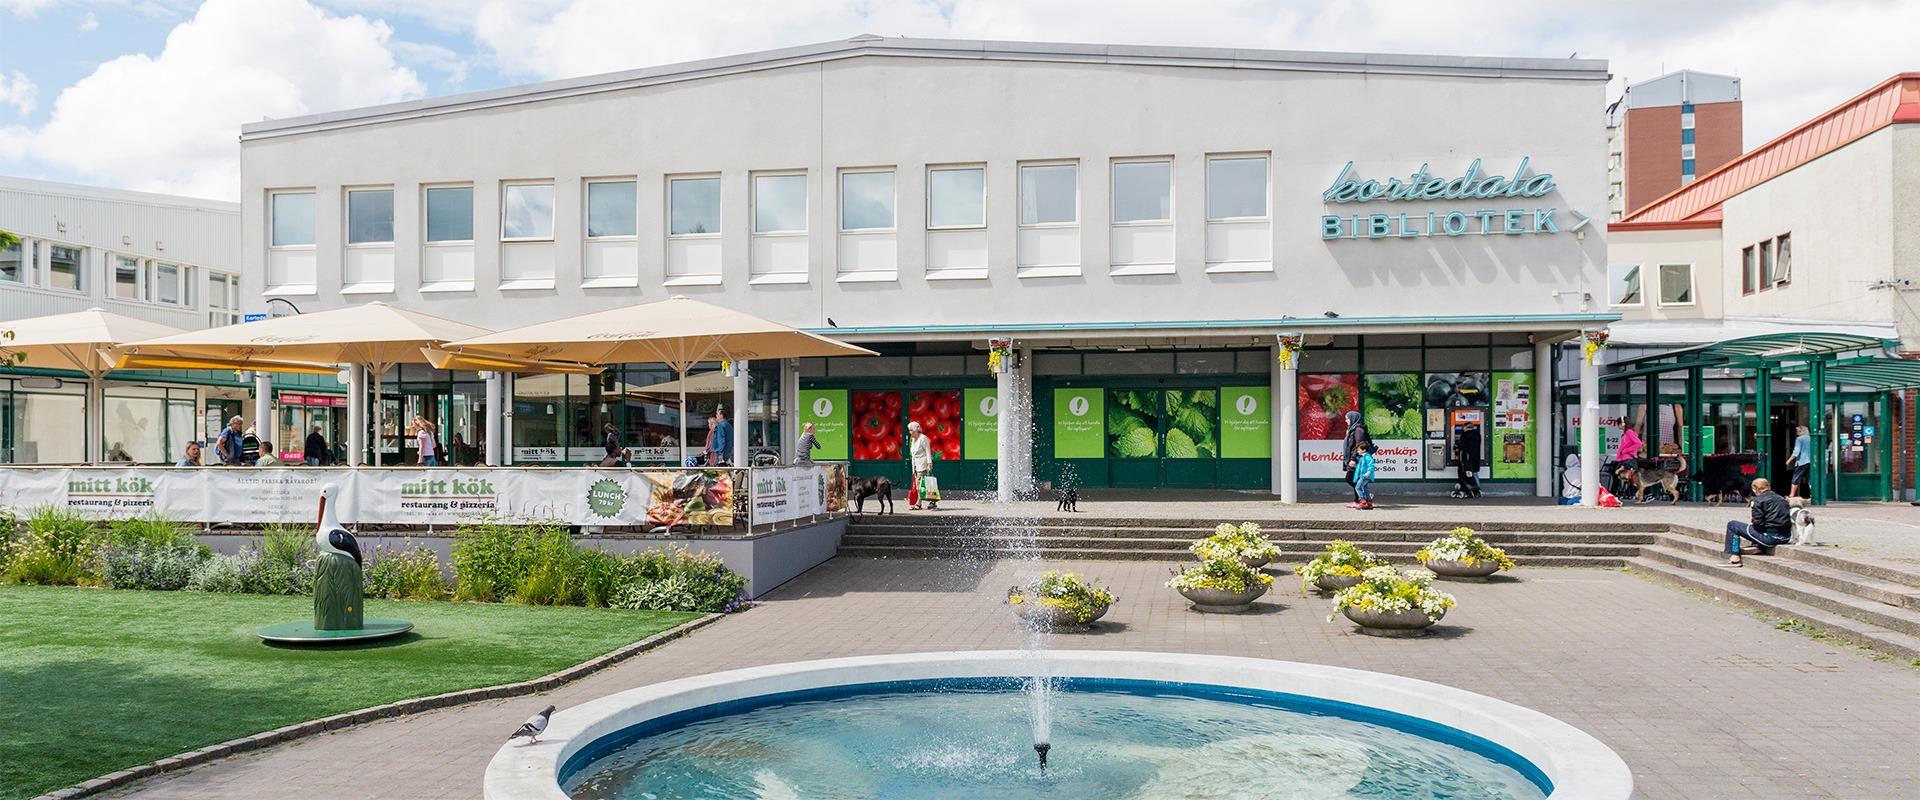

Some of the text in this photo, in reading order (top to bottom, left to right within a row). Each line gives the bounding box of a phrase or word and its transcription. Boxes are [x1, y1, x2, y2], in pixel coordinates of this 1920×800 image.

[1323, 156, 1557, 202] kortedala
[1321, 208, 1560, 240] BIBLIOTEK
[1374, 446, 1418, 457] emköp
[68, 477, 155, 493] mitt kök
[401, 478, 495, 495] mitt kök
[593, 491, 621, 500] LUNCH
[68, 498, 155, 507] restaurang & pizzeria
[401, 500, 495, 510] restaurang & pizzeria
